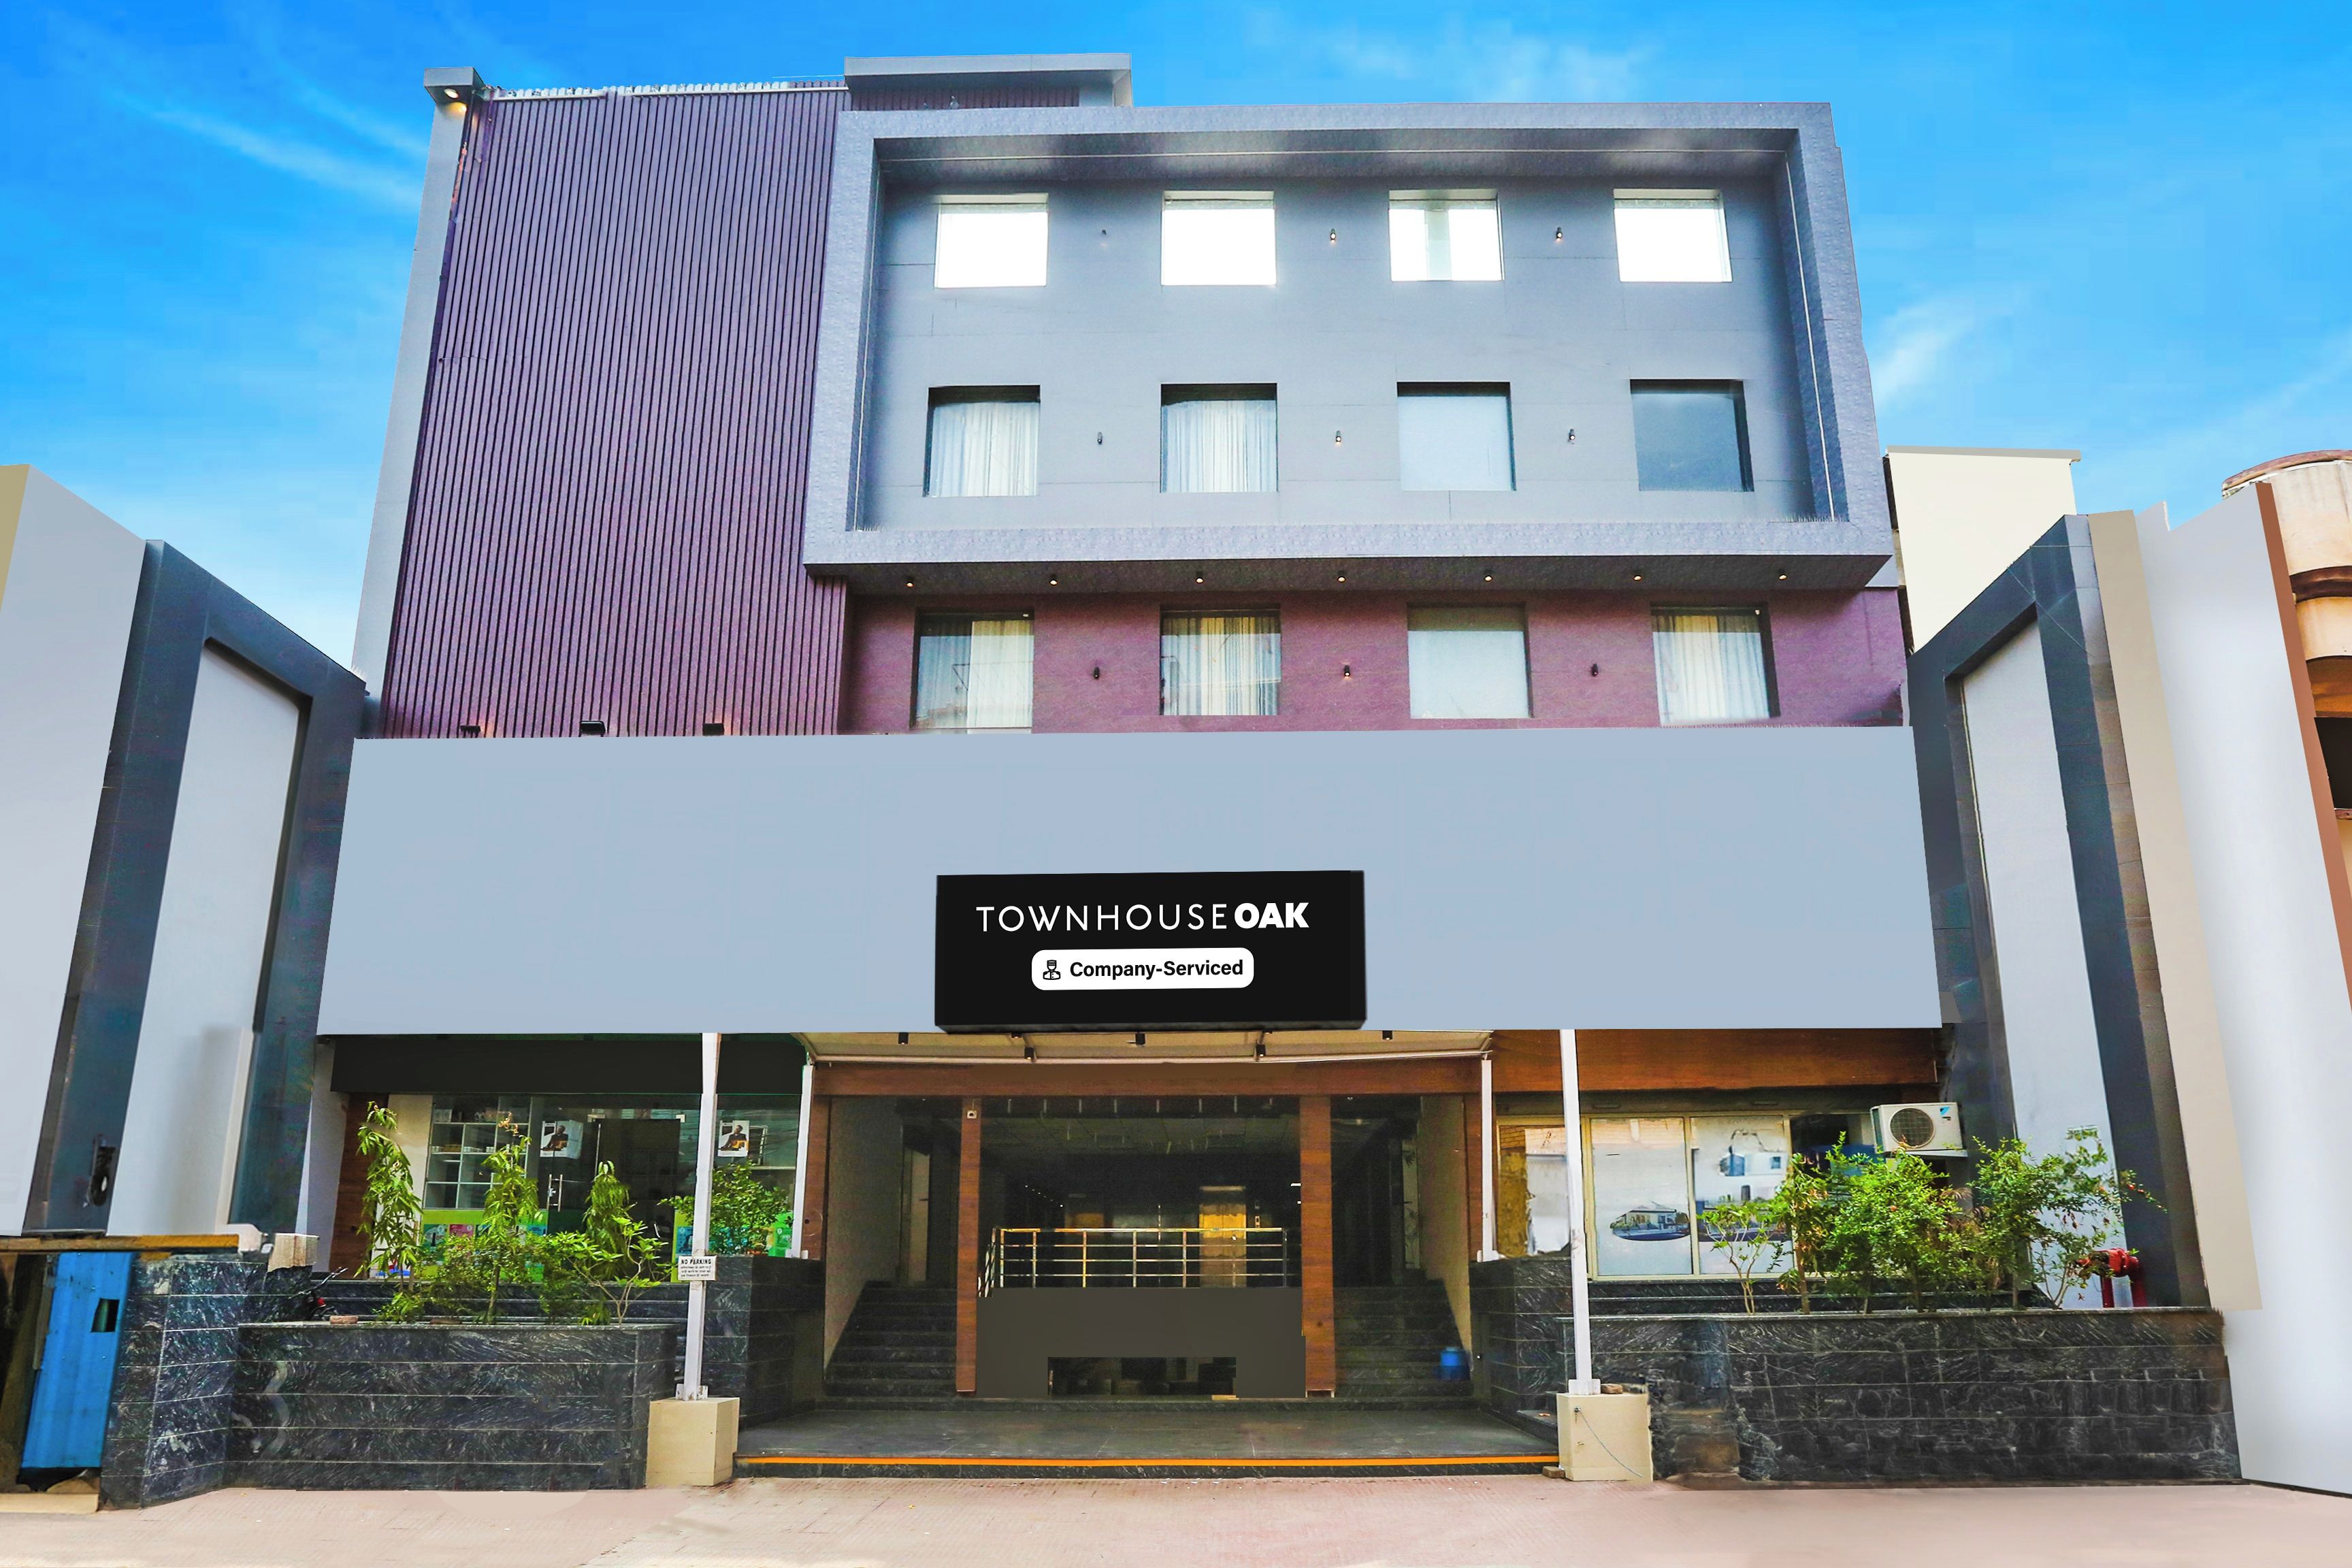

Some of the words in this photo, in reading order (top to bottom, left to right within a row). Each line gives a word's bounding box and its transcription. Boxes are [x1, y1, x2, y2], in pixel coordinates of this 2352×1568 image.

[976, 903, 1227, 932] TOWNHOUSE
[1234, 902, 1309, 929] OAK
[1070, 959, 1243, 981] Company-Serviced
